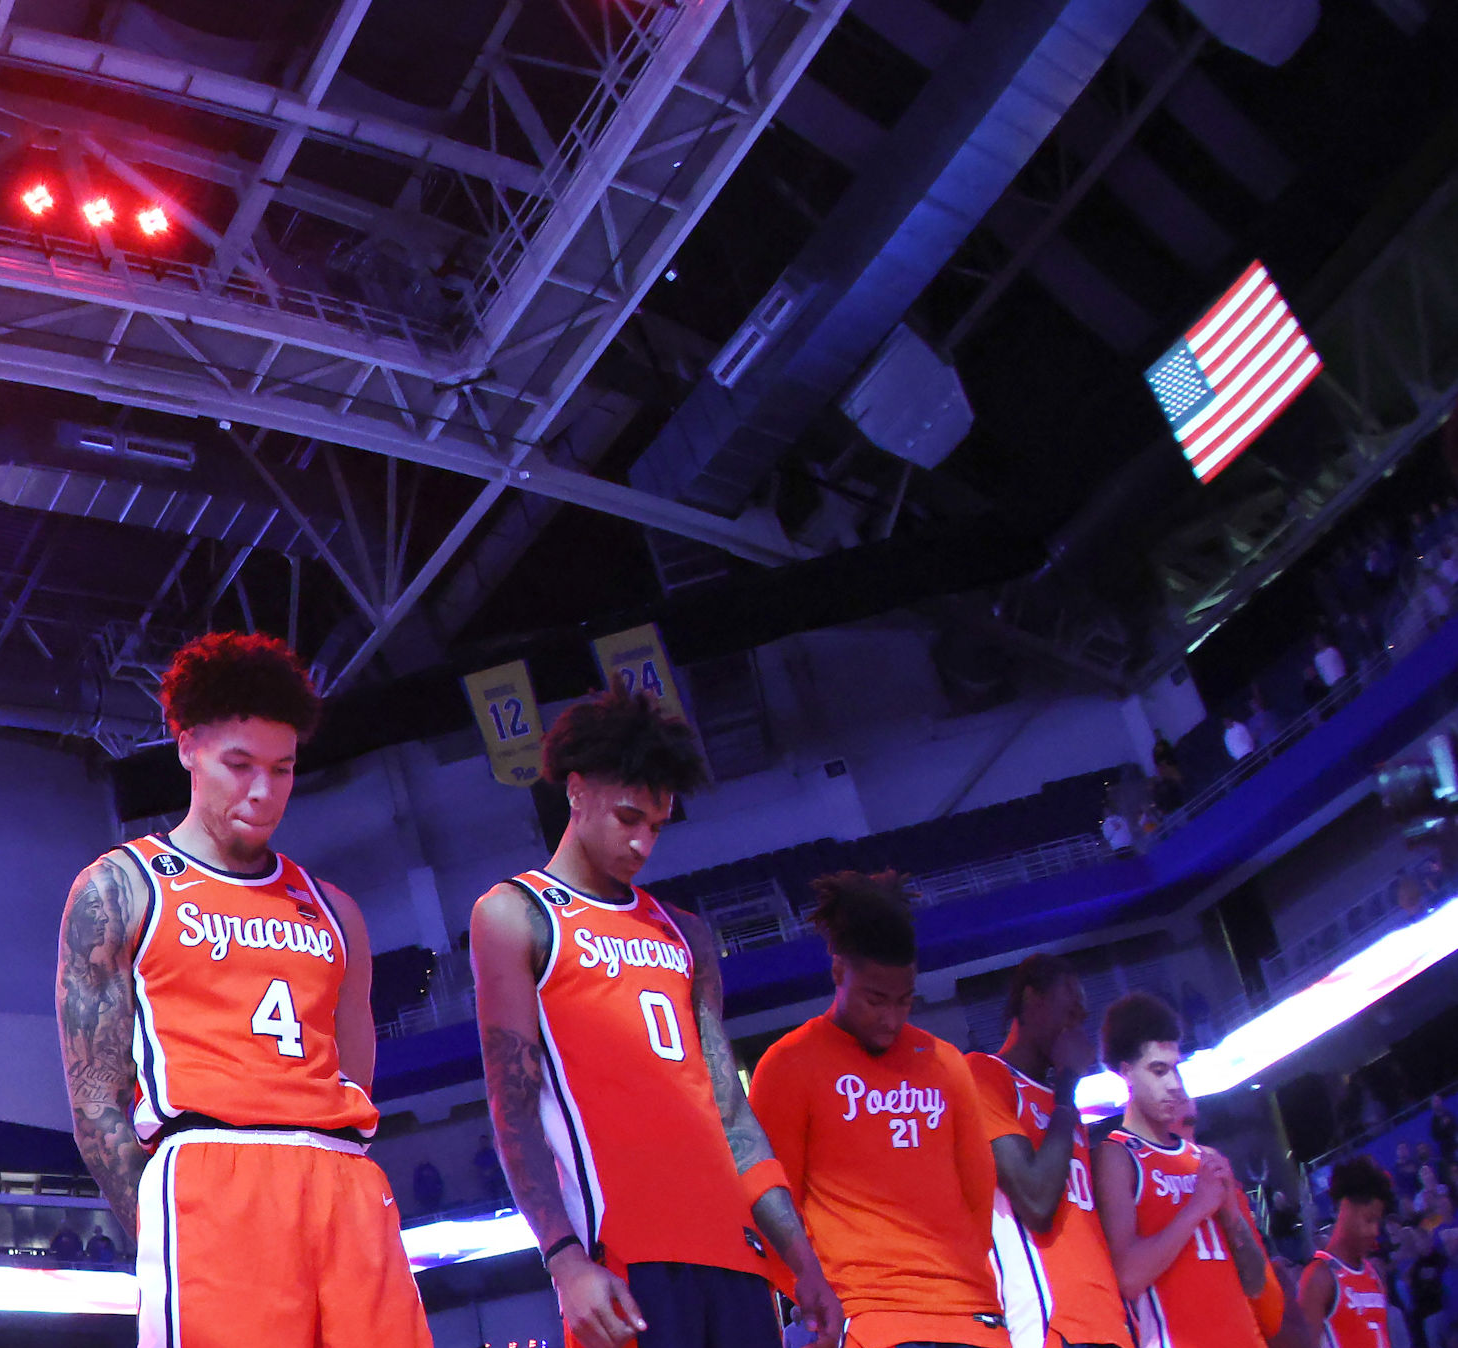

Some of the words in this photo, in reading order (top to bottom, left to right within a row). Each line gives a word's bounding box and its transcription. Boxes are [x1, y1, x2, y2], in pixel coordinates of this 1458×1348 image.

[489, 697, 531, 741] 12
[176, 902, 335, 963] Syracuse
[573, 927, 691, 979] Syracuse
[251, 978, 306, 1059] 4
[638, 989, 686, 1063] 0
[835, 1074, 946, 1130] Poetry
[889, 1118, 920, 1148] 21
